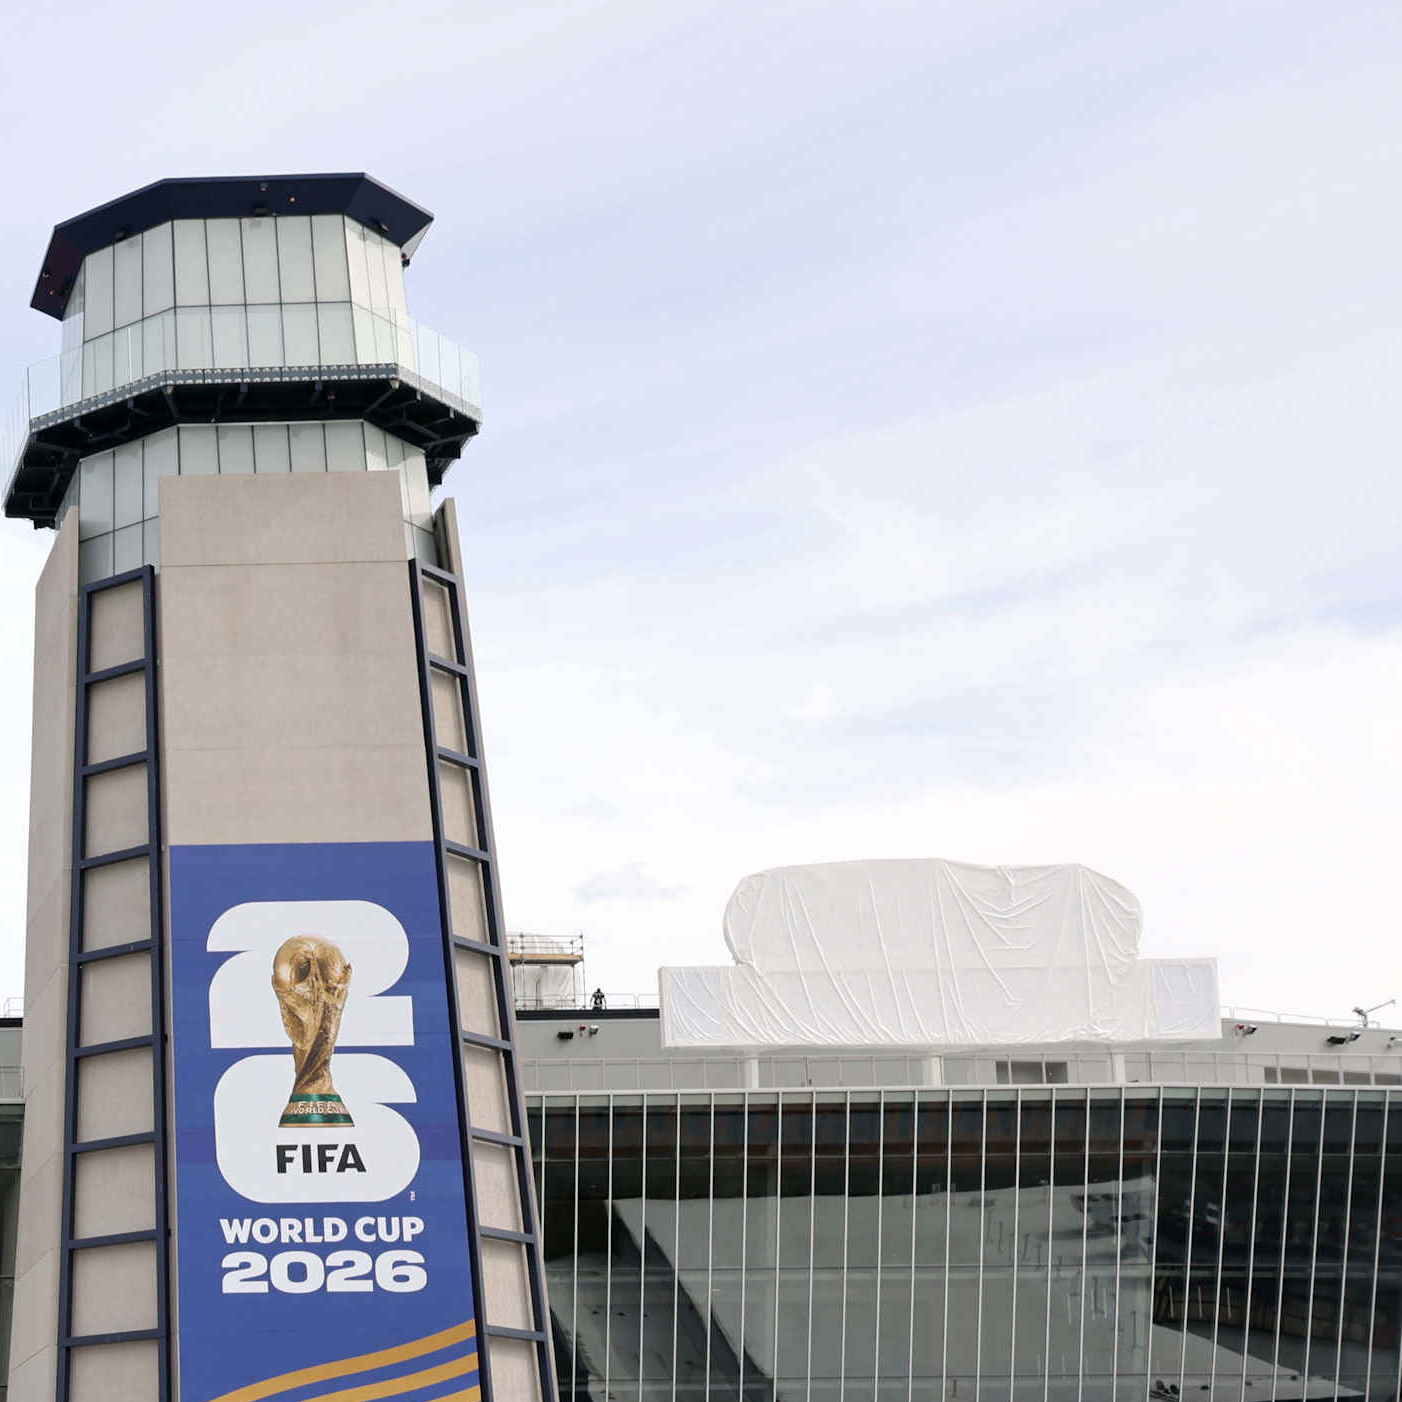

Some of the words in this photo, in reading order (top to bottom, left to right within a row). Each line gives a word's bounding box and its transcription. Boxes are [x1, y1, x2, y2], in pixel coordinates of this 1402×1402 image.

[276, 1143, 367, 1175] FIFA
[220, 1217, 348, 1244] WORLD
[354, 1216, 425, 1243] CUP
[221, 1250, 429, 1295] 2026
